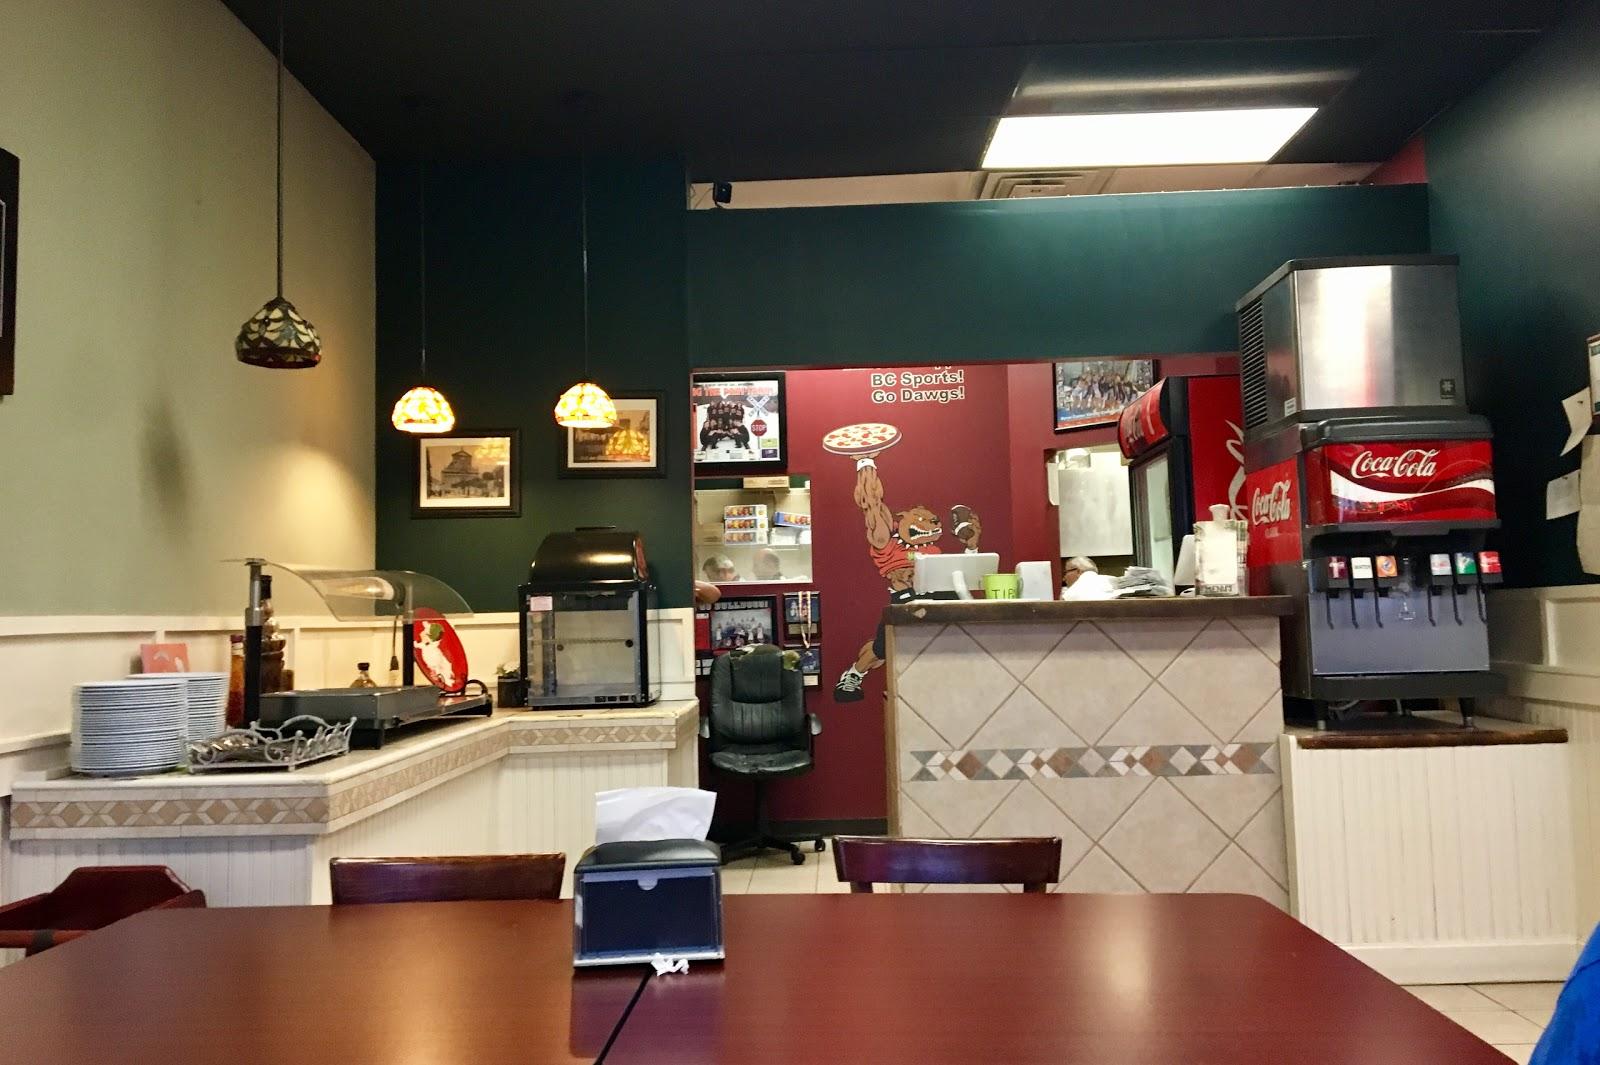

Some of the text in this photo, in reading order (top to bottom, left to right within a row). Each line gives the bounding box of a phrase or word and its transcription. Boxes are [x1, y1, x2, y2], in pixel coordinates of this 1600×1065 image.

[871, 369, 964, 388] BC Sports!
[872, 386, 965, 403] Go Dawgs!
[751, 424, 767, 432] STOP
[1351, 449, 1440, 478] Coca-Cola
